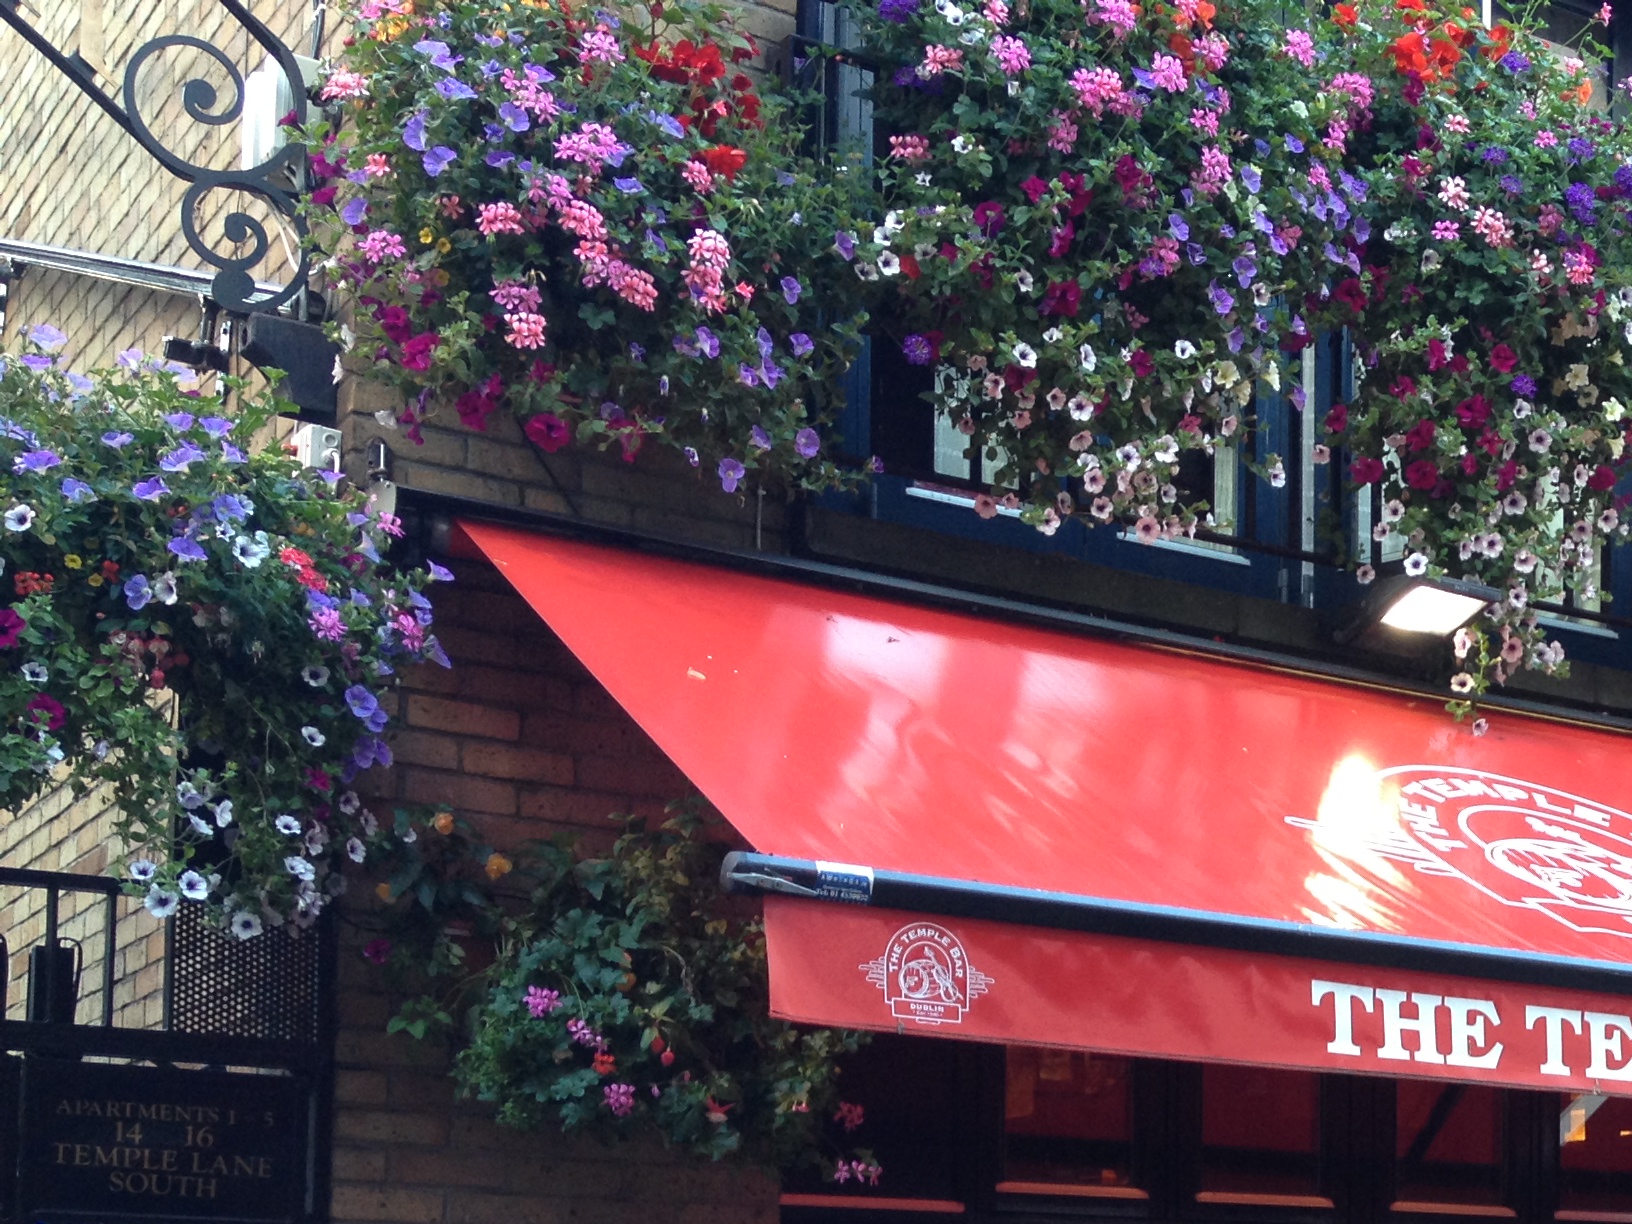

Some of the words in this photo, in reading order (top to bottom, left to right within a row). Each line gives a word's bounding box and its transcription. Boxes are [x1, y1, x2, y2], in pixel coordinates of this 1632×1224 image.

[1400, 777, 1611, 828] TEMPLE
[1401, 798, 1467, 852] THE
[888, 943, 903, 973] THE
[900, 928, 951, 947] TEMPLE
[949, 946, 964, 978] BAR
[1311, 978, 1504, 1070] THE
[55, 1099, 220, 1124] APARTMENTS
[115, 1121, 143, 1145] 14
[184, 1125, 214, 1148] 16
[54, 1142, 178, 1172] TEMPLE
[191, 1151, 273, 1179] LANE
[109, 1170, 217, 1199] SOUTH
